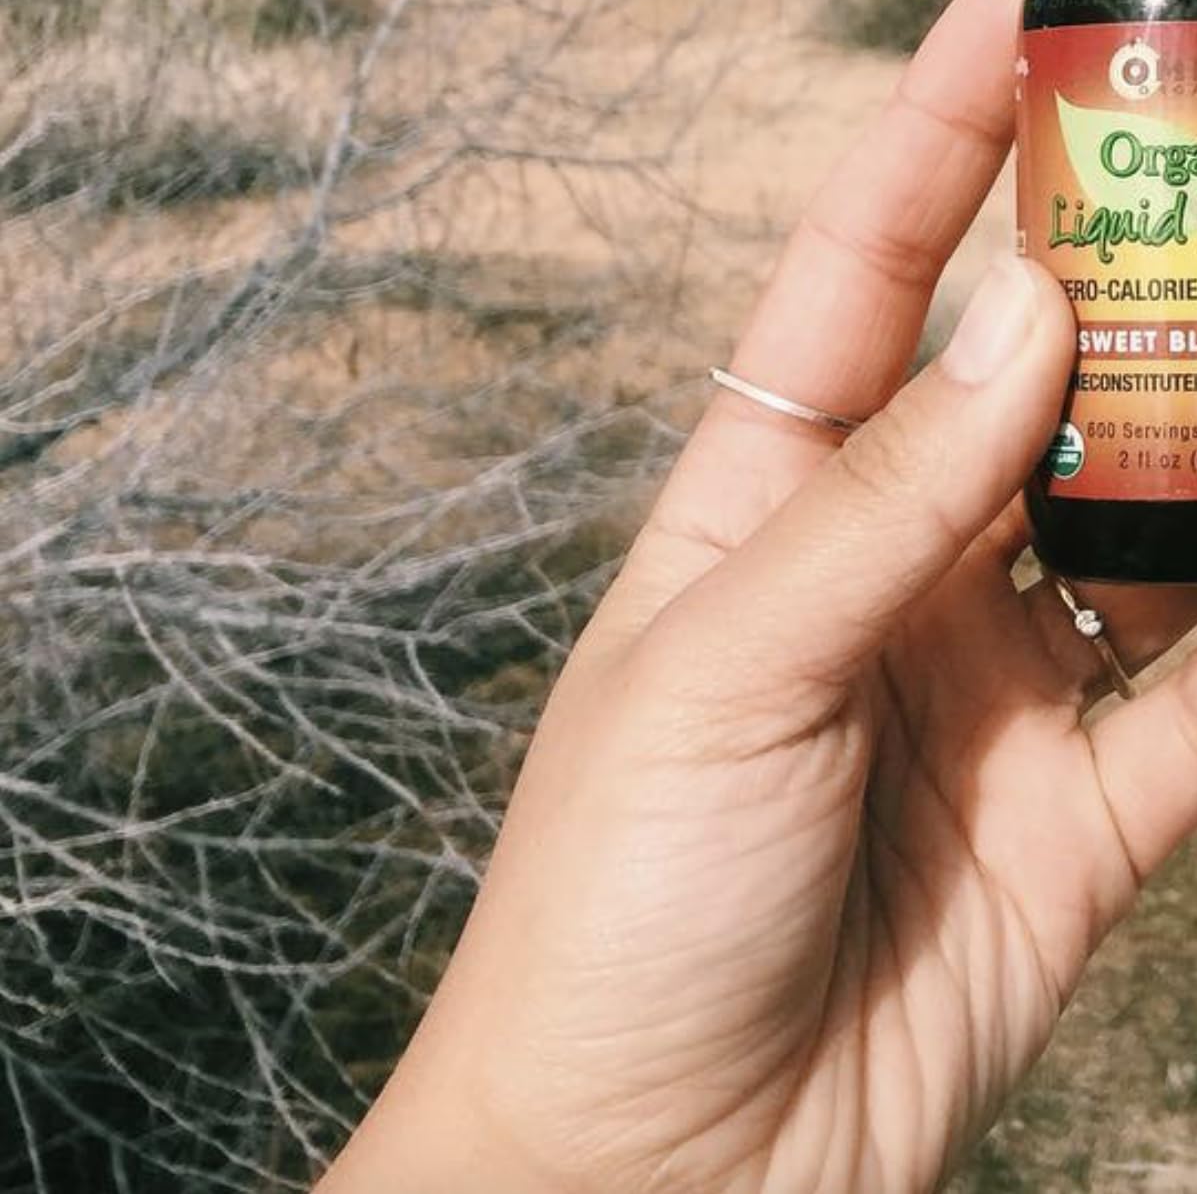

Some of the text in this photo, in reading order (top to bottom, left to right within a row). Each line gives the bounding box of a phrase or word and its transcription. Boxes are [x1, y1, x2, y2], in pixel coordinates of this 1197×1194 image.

[1049, 191, 1188, 263] Liquid
[1060, 278, 1197, 301] ERO-CALORIE
[1079, 330, 1156, 353] SWEET
[1119, 451, 1129, 469] 2
[1160, 454, 1182, 469] oz
